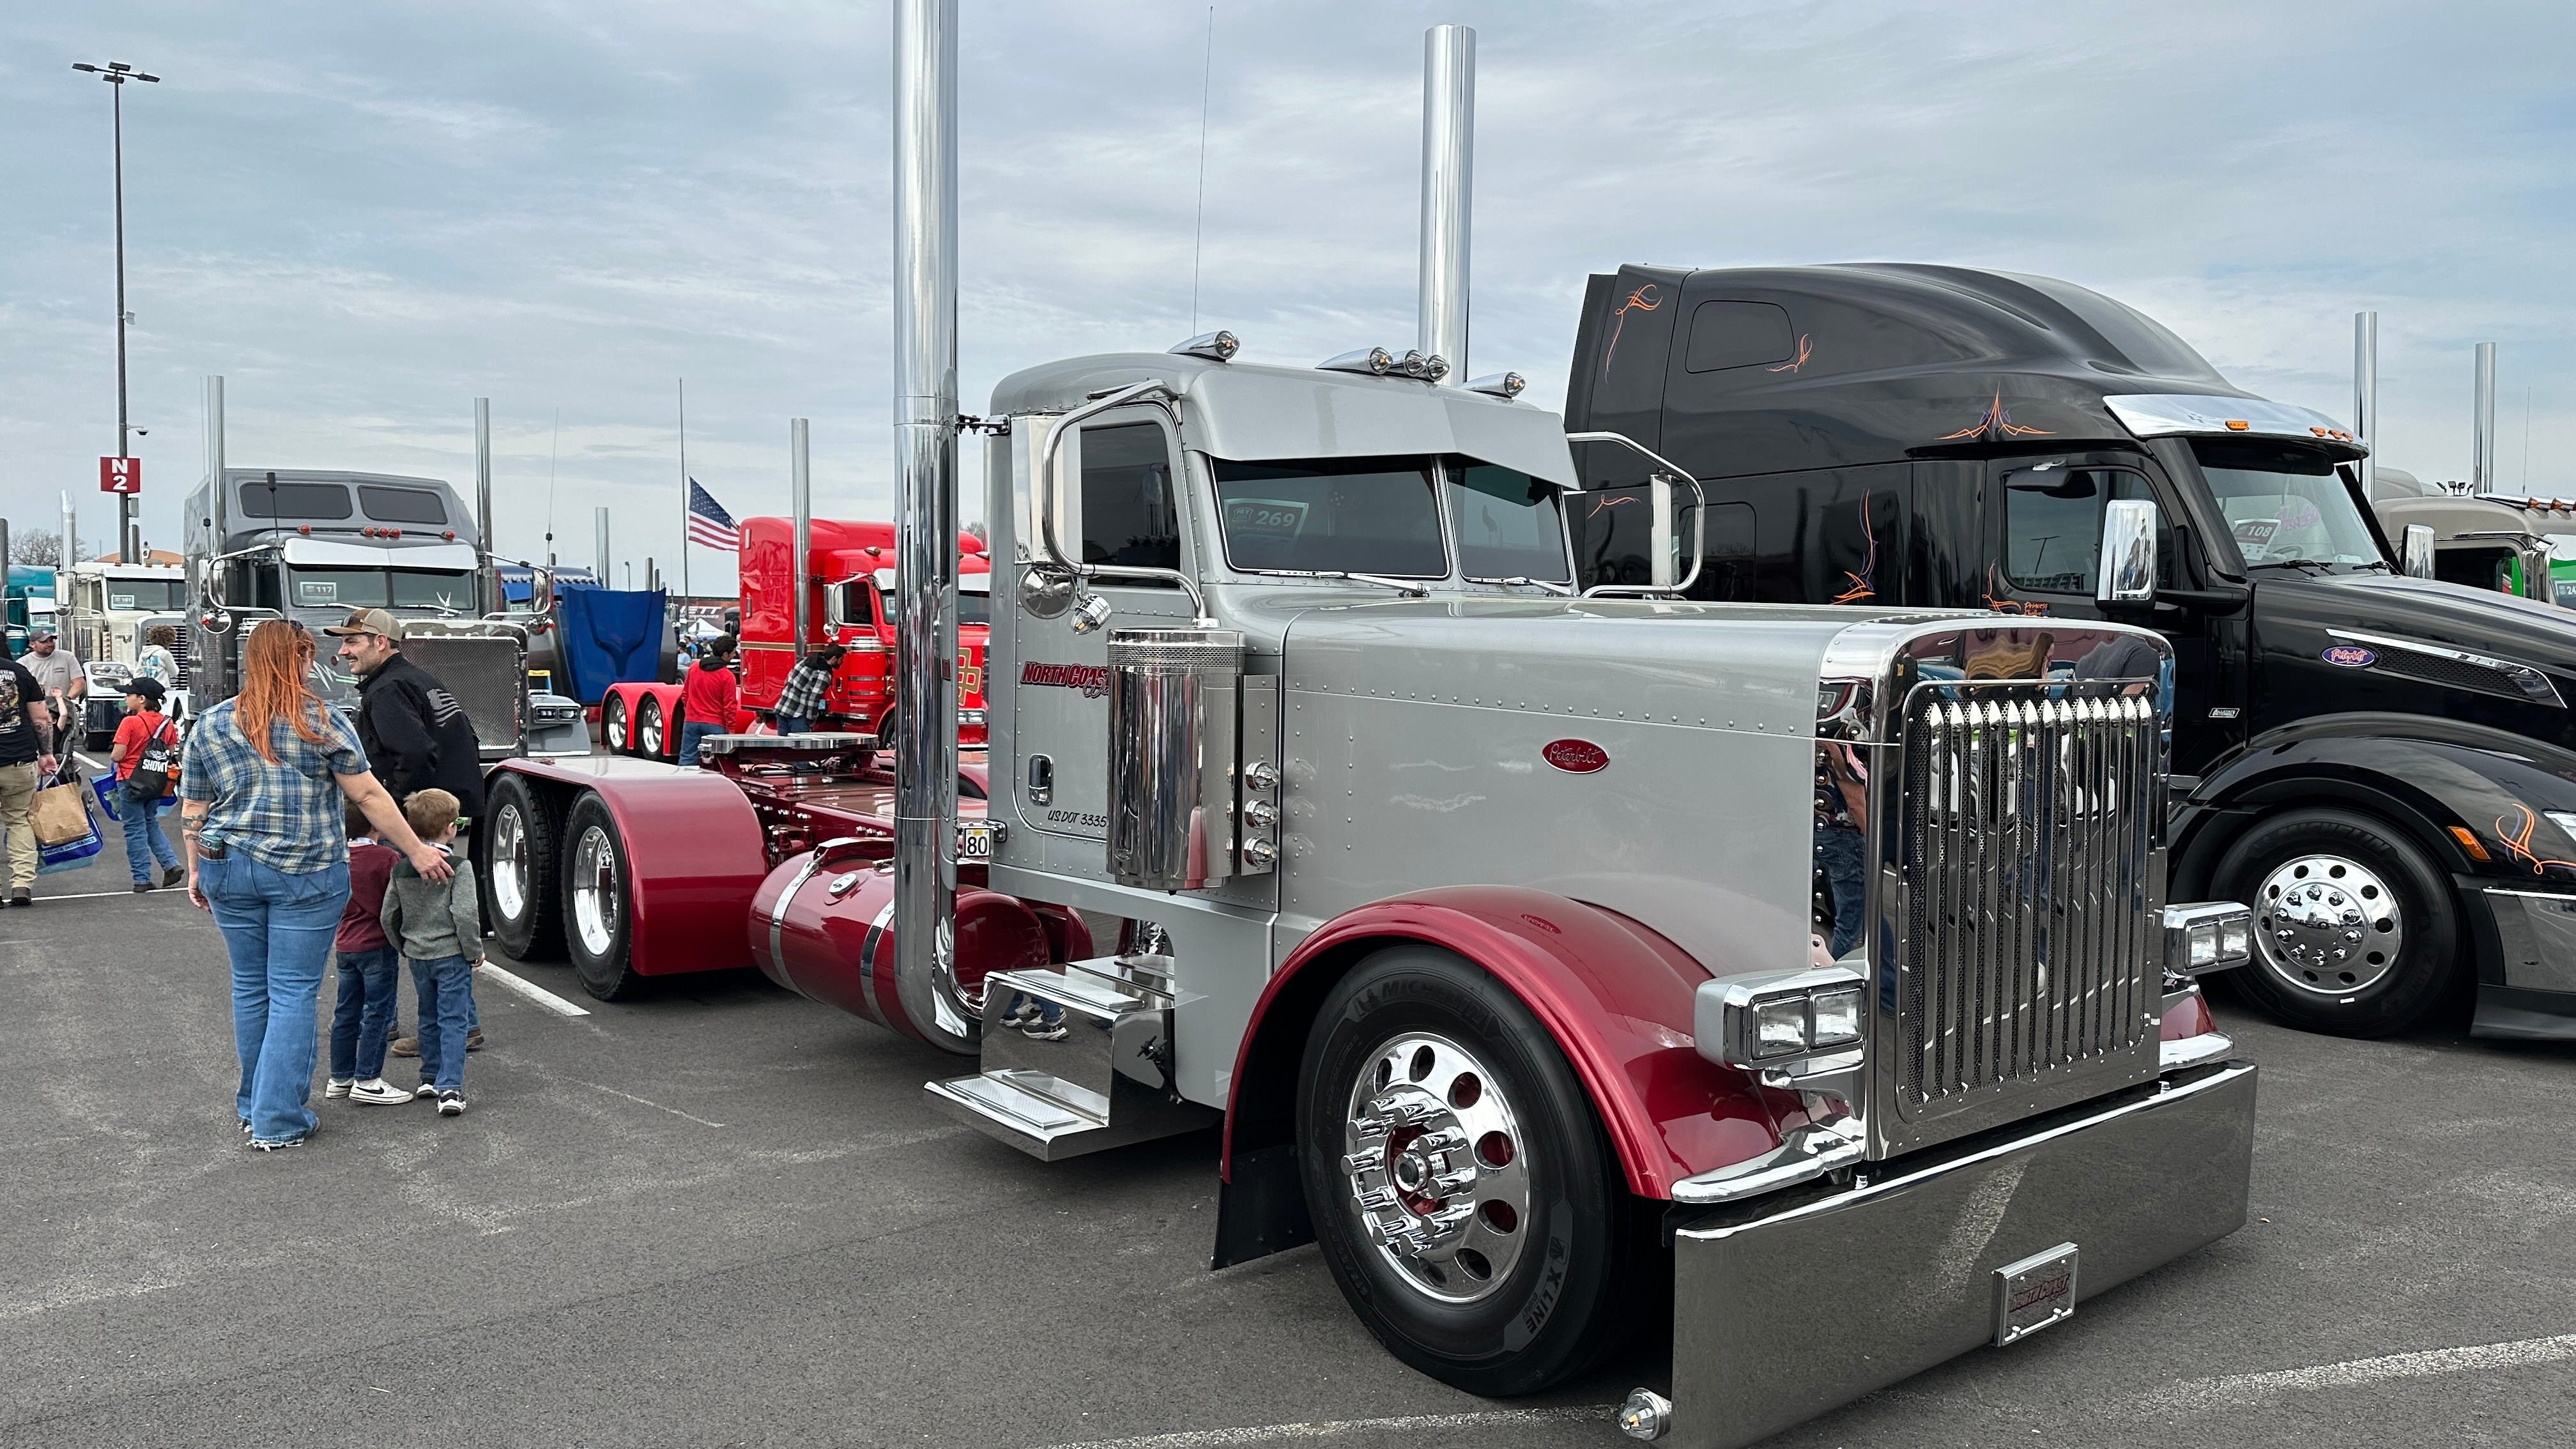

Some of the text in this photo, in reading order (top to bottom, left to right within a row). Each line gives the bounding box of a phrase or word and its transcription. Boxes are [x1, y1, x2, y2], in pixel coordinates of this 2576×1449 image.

[111, 459, 128, 474] N
[112, 475, 128, 491] 2
[1255, 510, 1296, 527] 269
[2248, 525, 2273, 537] 108
[1020, 661, 1071, 687] NORTH
[1549, 743, 1602, 763] Peterbilt
[1048, 809, 1061, 822] US
[1061, 811, 1080, 824] DOT
[65, 837, 96, 850] INSURANCE
[967, 836, 988, 855] 80
[1381, 978, 1488, 1025] MICHELIN
